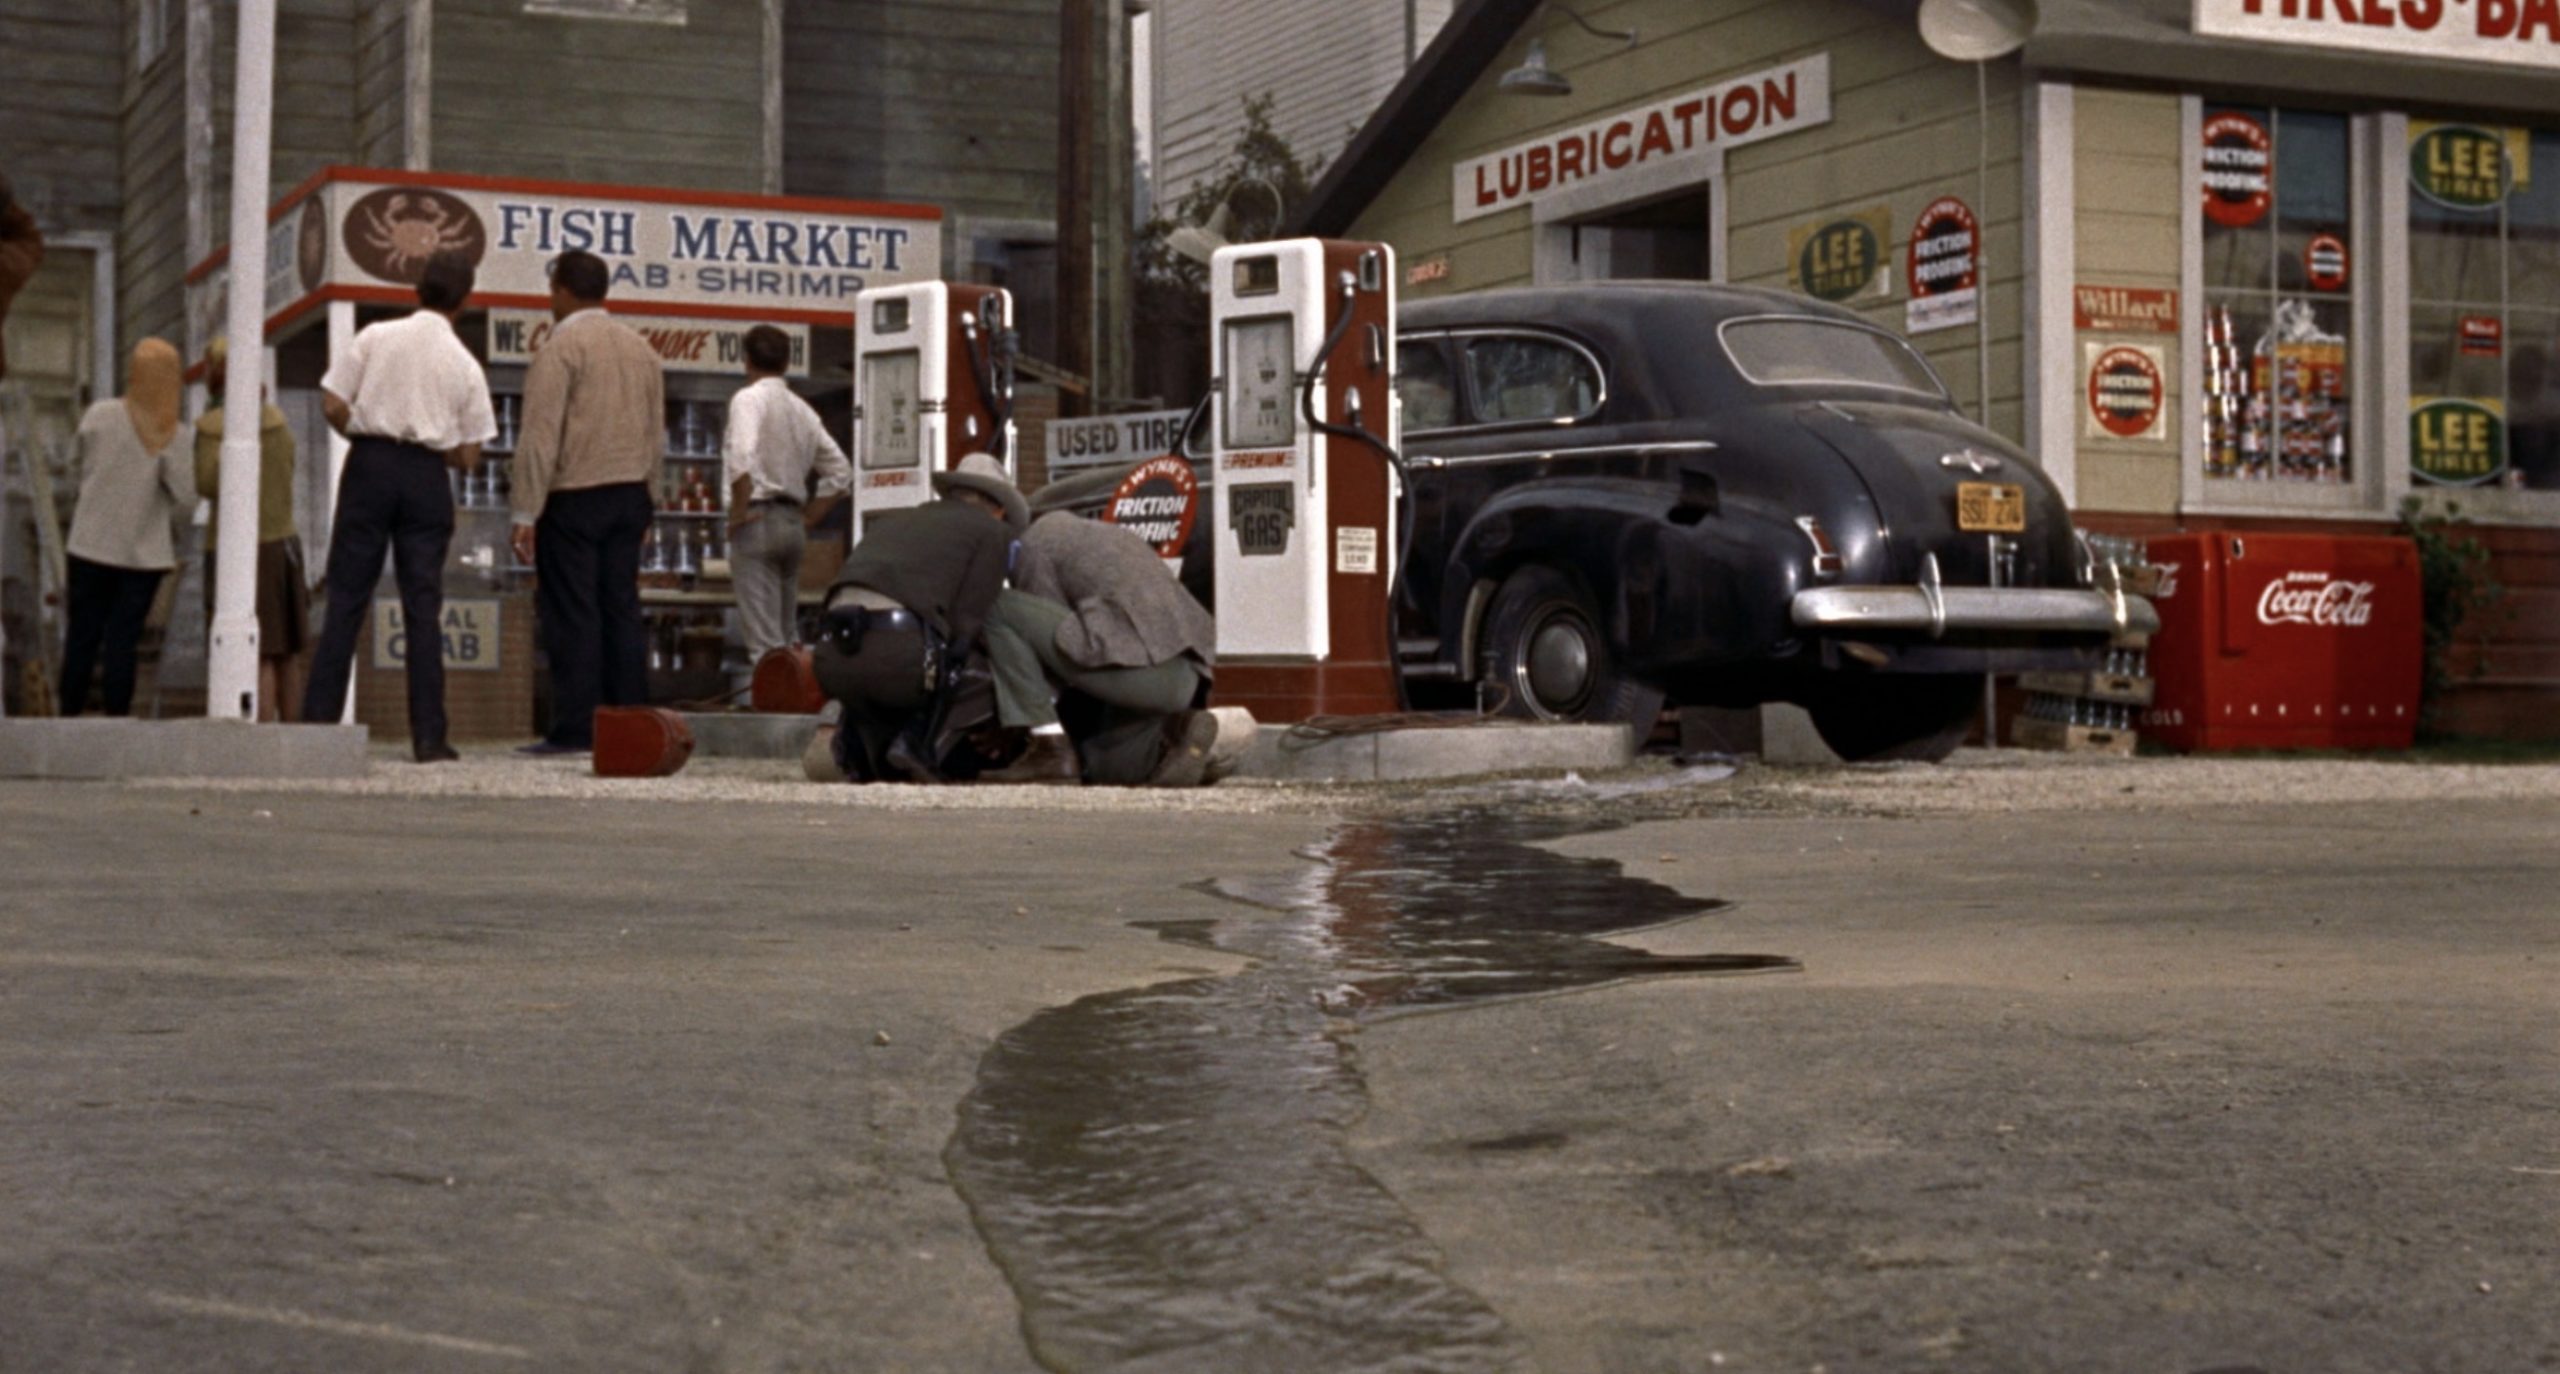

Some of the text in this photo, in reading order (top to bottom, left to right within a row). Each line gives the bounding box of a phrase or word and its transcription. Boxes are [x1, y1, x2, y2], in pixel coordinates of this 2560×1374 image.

[1475, 72, 1797, 207] LUBRICATION
[2428, 134, 2498, 179] LEE
[2430, 176, 2499, 199] TIRES
[498, 204, 908, 271] FISH MARKET
[1812, 226, 1865, 277] LEE
[1915, 230, 1973, 260] FRICTION
[696, 266, 865, 300] SHRIMP
[2077, 287, 2174, 321] Willard
[494, 319, 526, 352] WE
[1057, 416, 1184, 459] USED TIRE
[2419, 411, 2490, 450] LEE
[1129, 459, 1189, 486] WYNN'S
[1230, 452, 1288, 469] PREMIUM
[2421, 453, 2491, 473] TIRES
[872, 472, 908, 487] SUPER
[1113, 496, 1188, 518] FRICTION
[1232, 487, 1294, 517] CAPITOL
[1243, 514, 1283, 549] GAS
[389, 607, 479, 630] LAL
[2256, 578, 2376, 627] Coca-Cola
[387, 633, 480, 661] CAB
